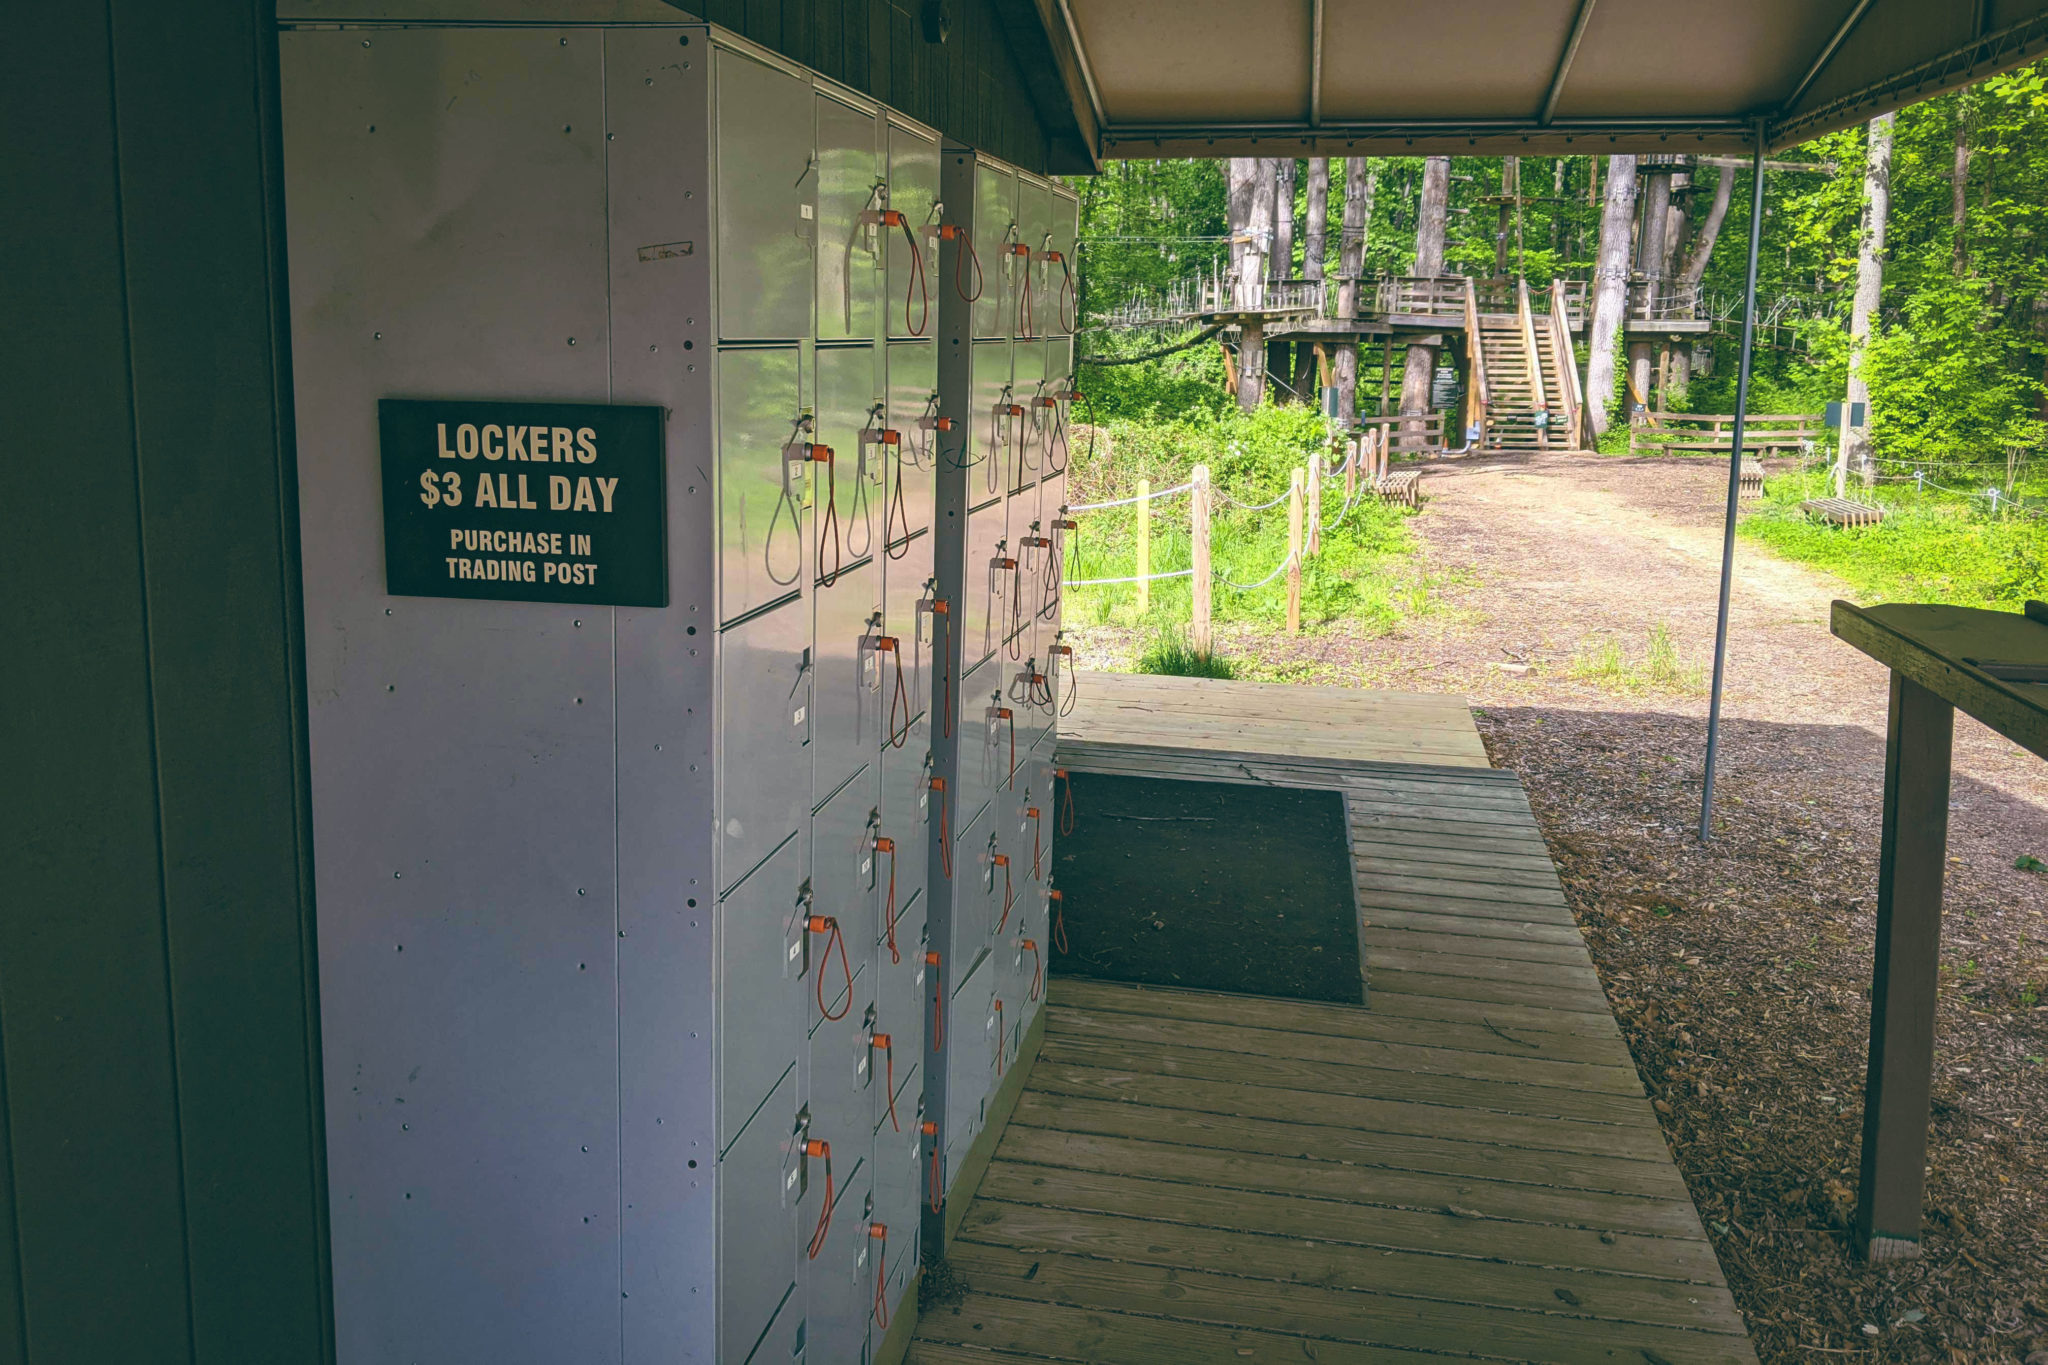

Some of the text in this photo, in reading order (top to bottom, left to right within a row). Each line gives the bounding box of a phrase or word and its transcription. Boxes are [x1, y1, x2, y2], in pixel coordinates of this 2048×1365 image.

[437, 423, 597, 464] LOCKERS
[420, 468, 619, 513] $3 ALL DAY
[450, 528, 591, 556] PURCHASE IN
[445, 557, 598, 585] TRADING POST
